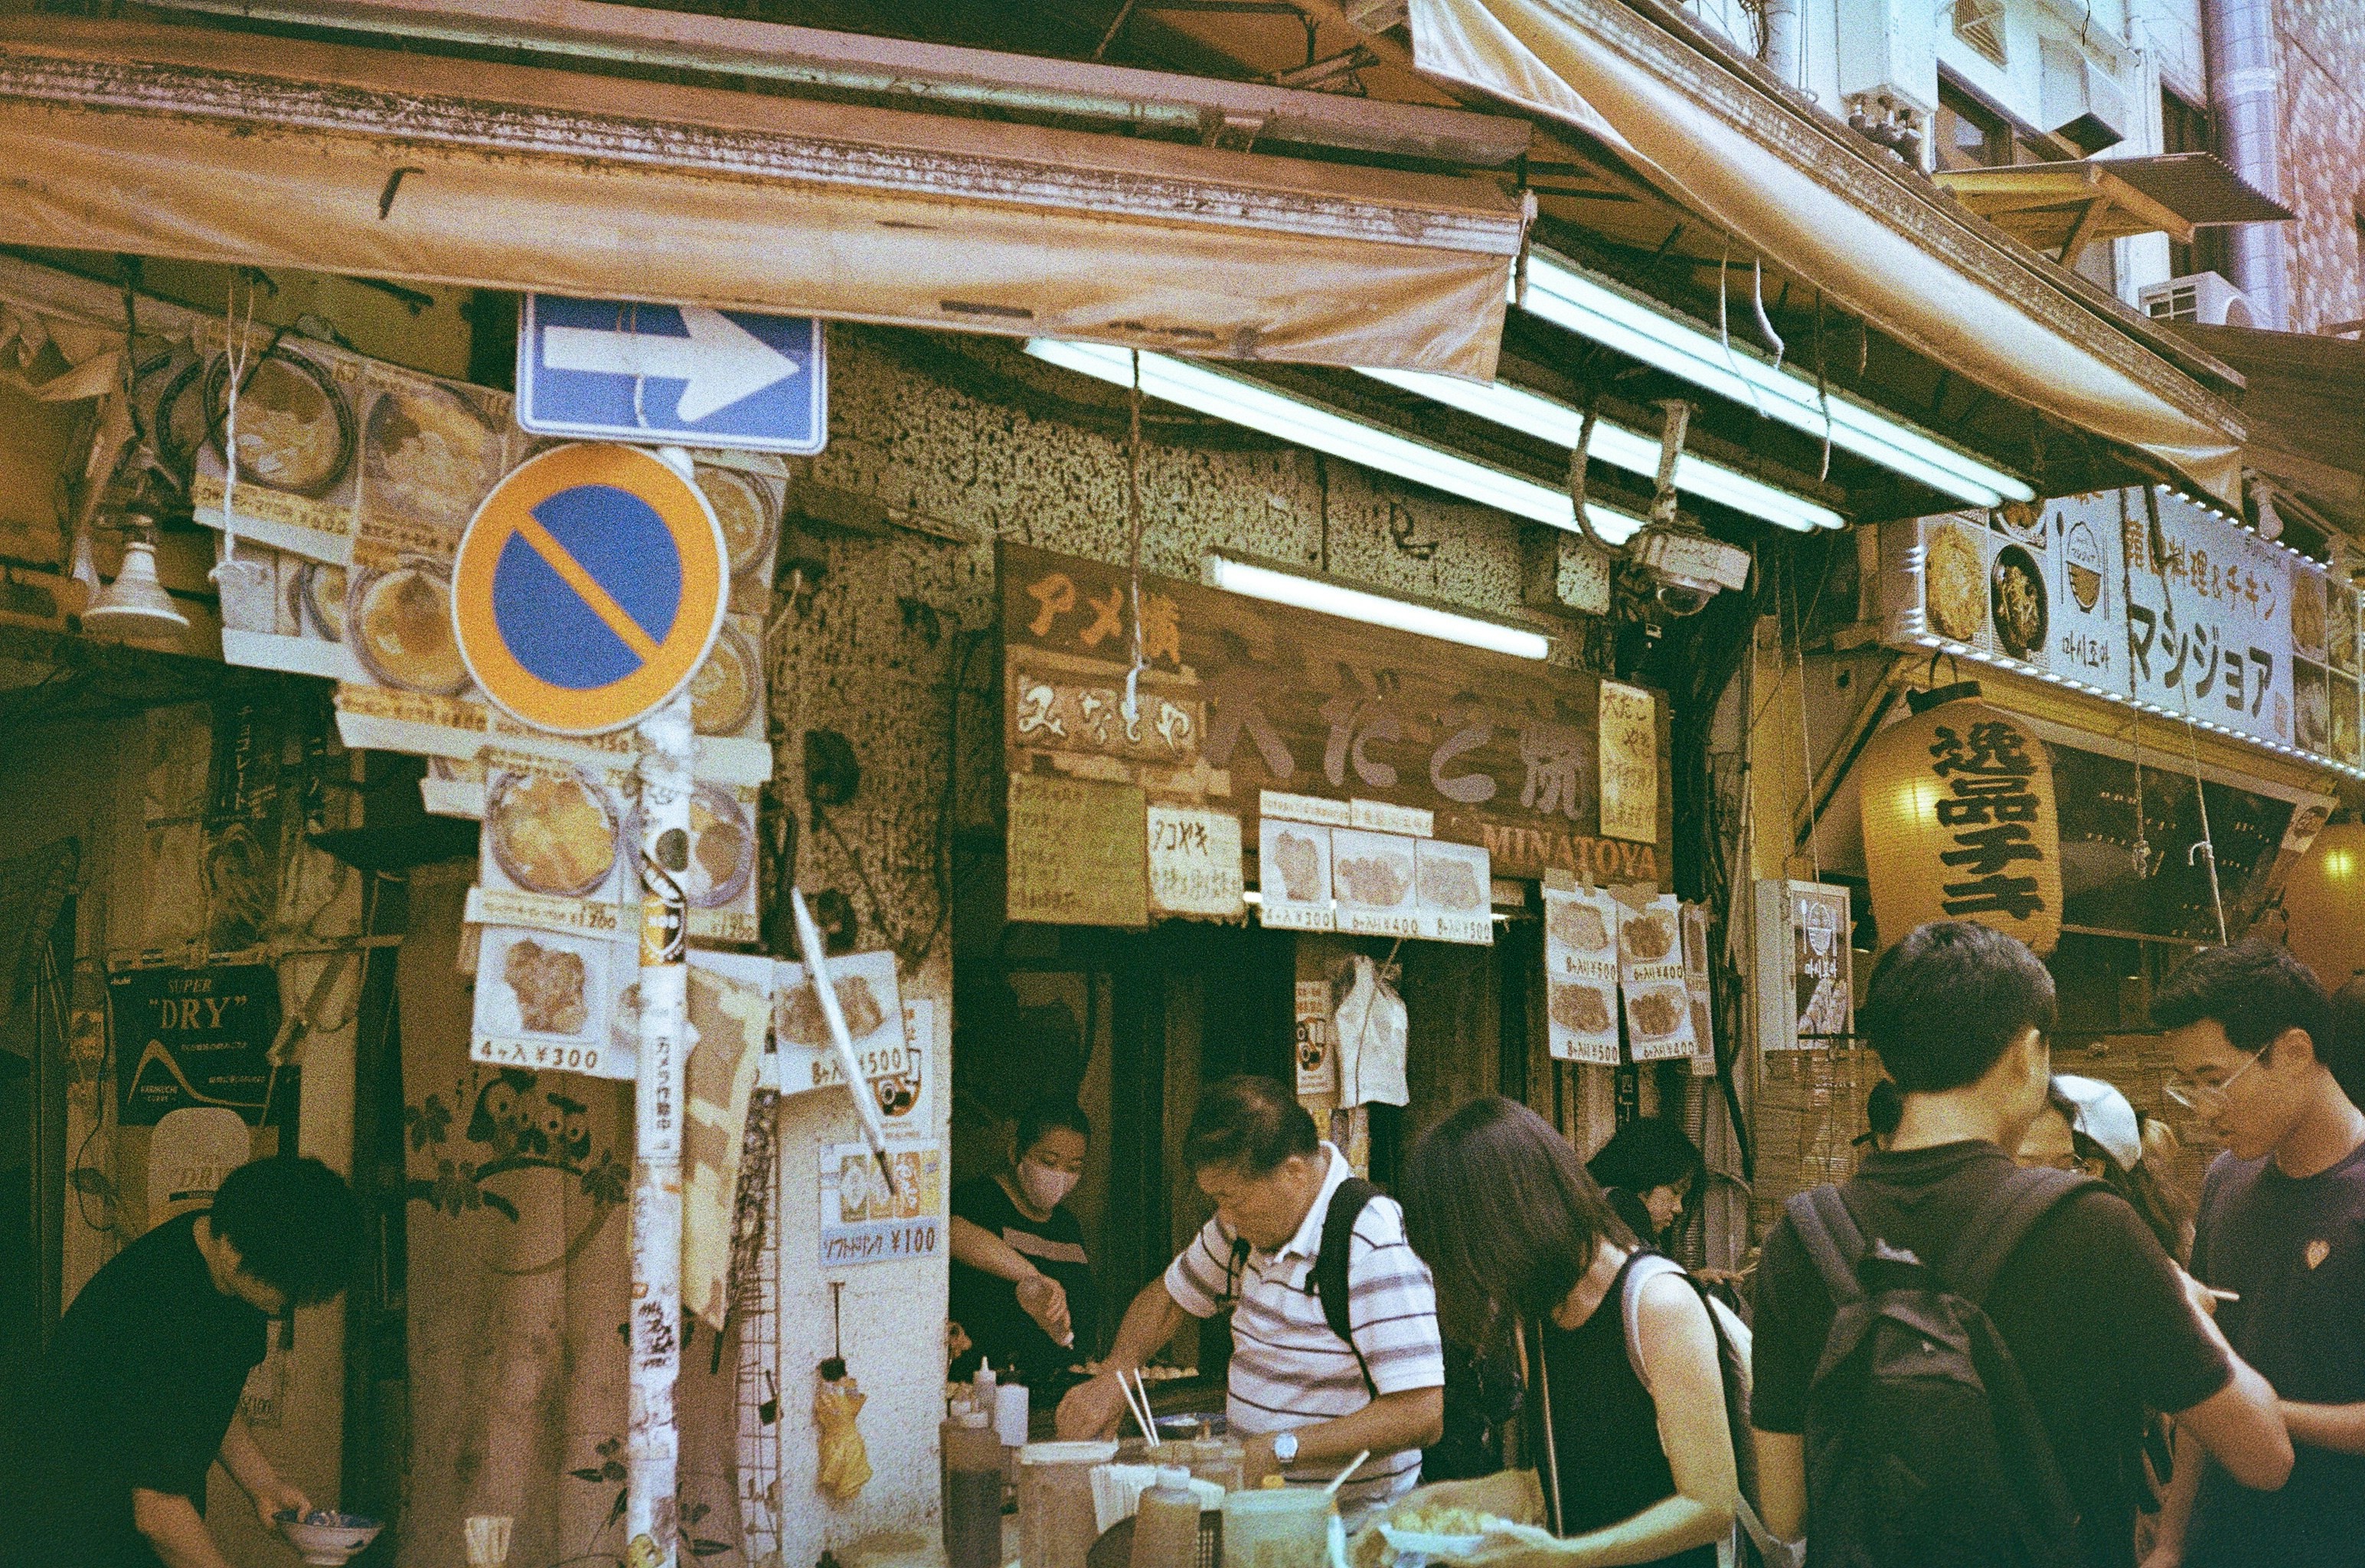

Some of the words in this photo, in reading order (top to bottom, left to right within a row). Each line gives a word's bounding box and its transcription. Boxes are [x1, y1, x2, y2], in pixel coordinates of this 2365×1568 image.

[1026, 573, 1181, 665] アメ横
[2130, 602, 2273, 718] マシジョア
[1928, 721, 2046, 921] 逸品チキ
[1478, 822, 1659, 879] MINATOYA
[167, 978, 213, 994] SUPER
[536, 1045, 598, 1069] ¥300
[890, 1226, 936, 1253] ¥100
